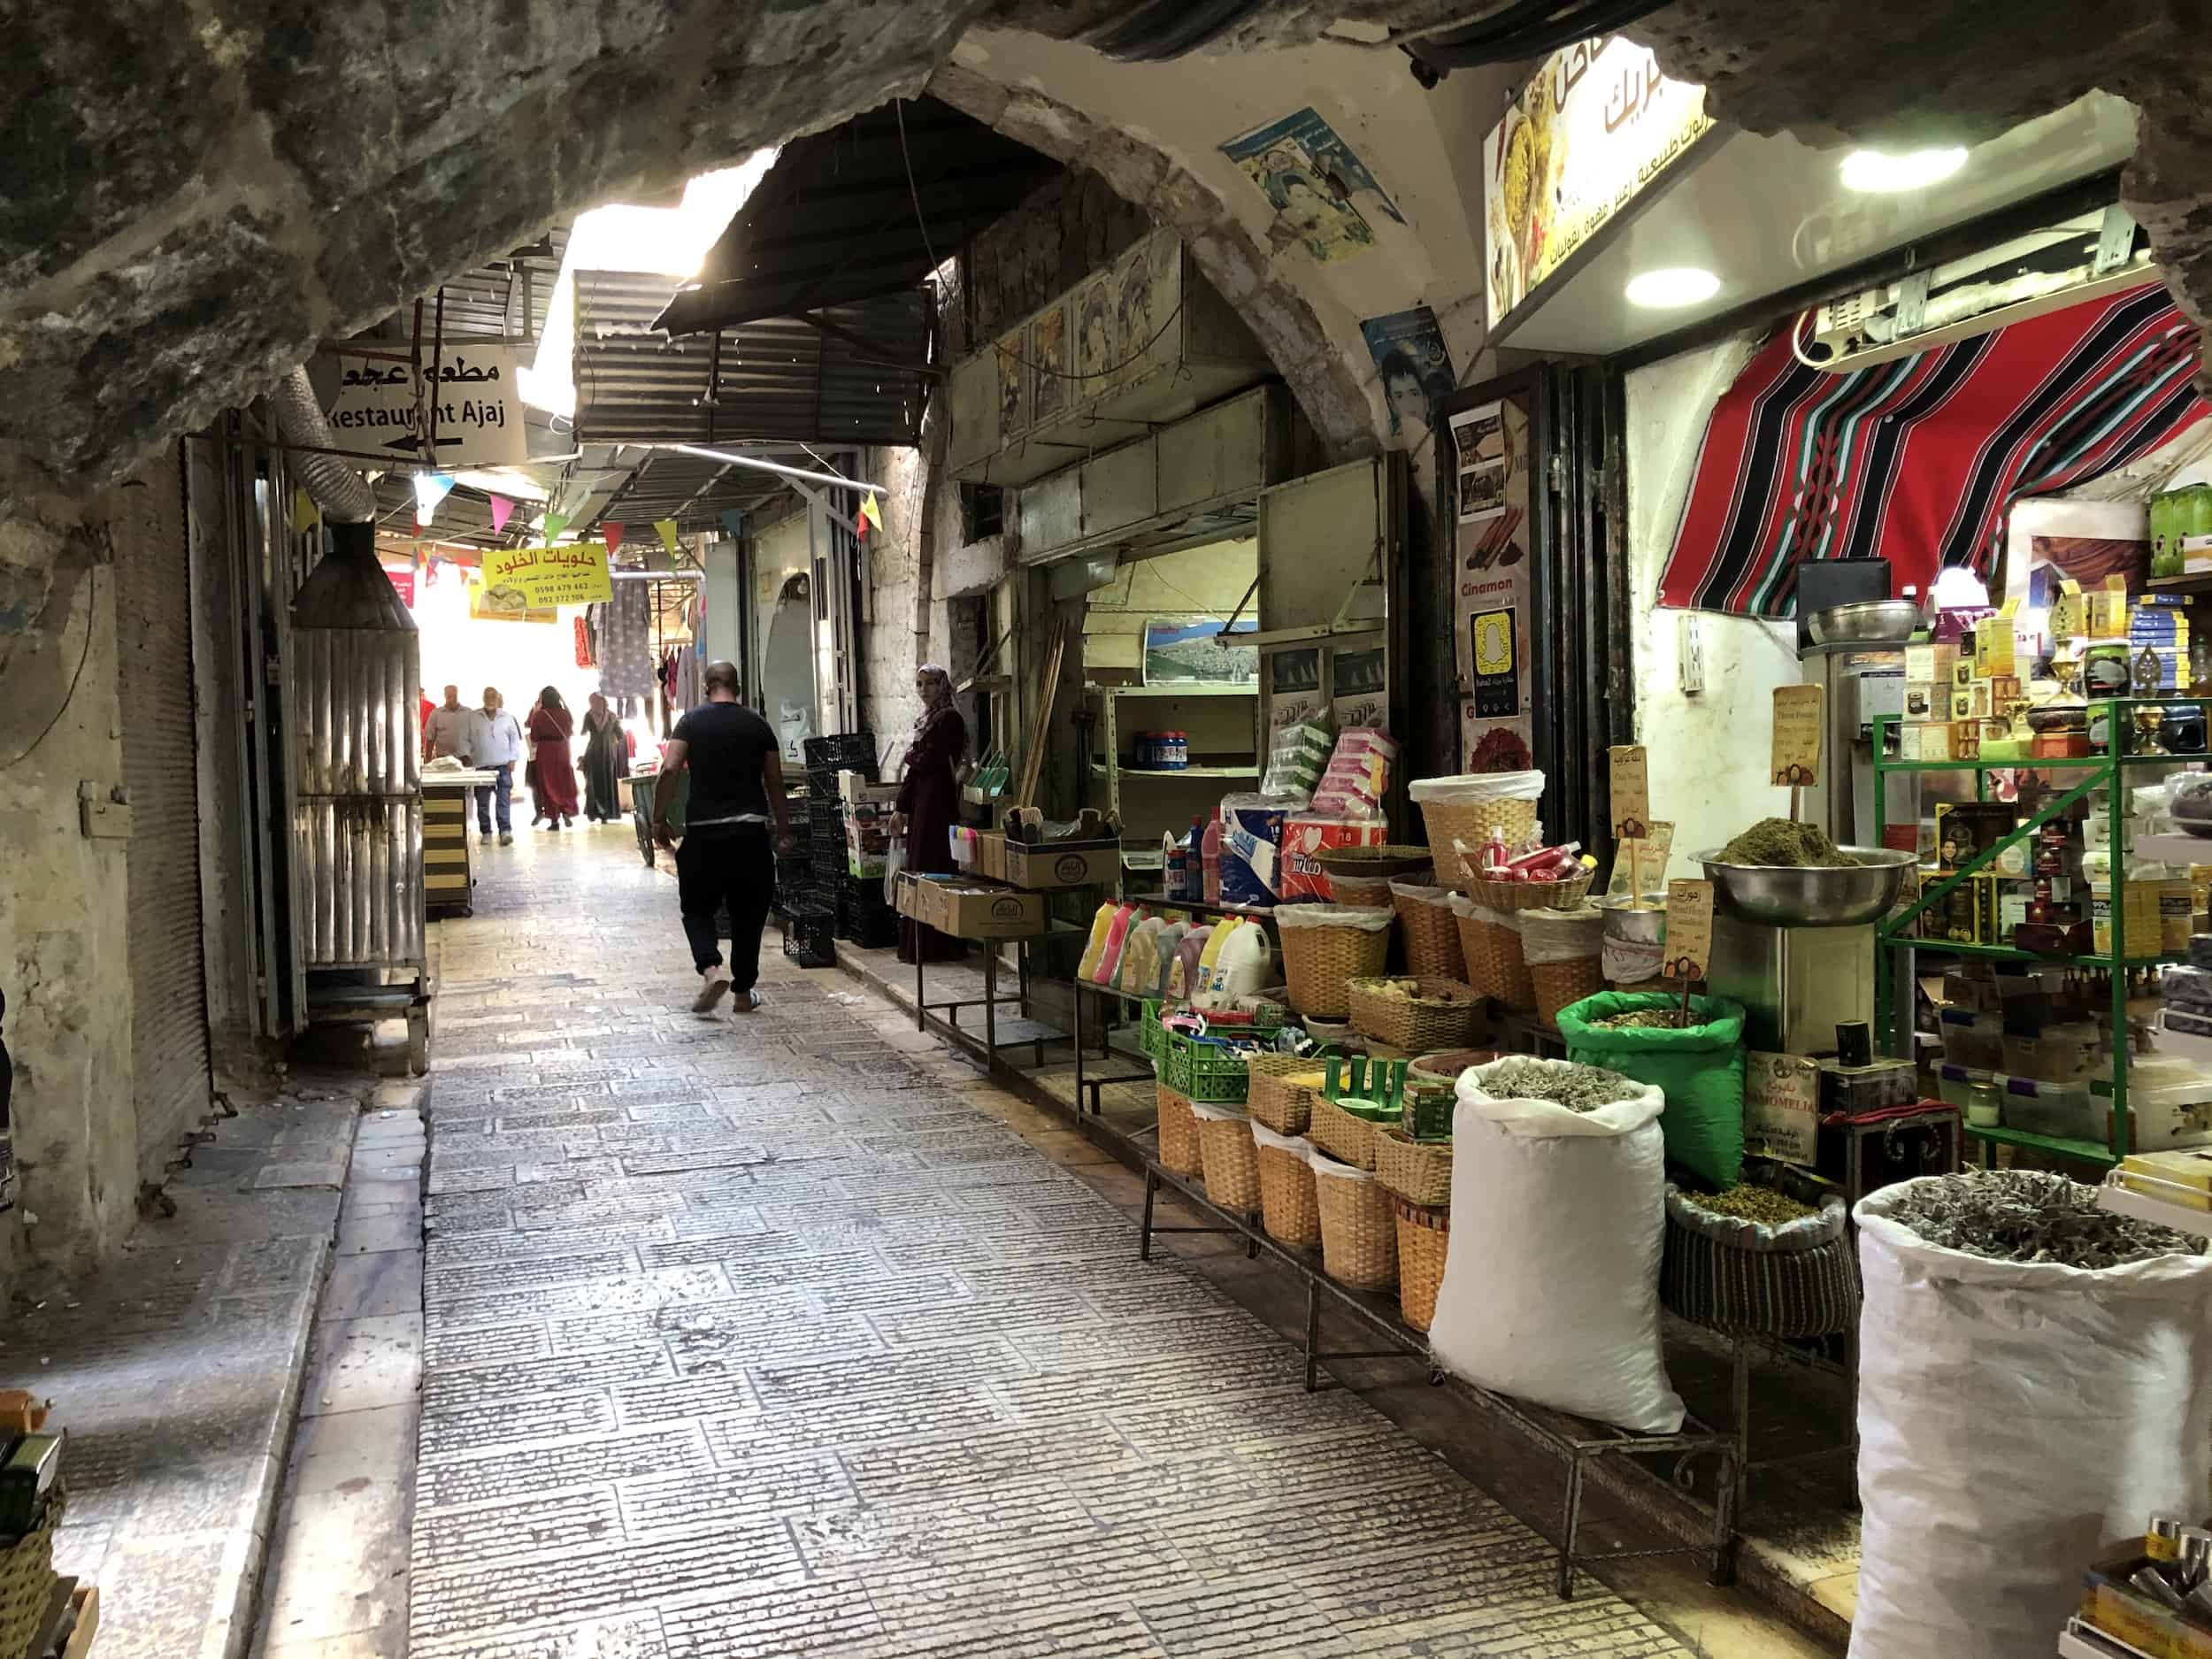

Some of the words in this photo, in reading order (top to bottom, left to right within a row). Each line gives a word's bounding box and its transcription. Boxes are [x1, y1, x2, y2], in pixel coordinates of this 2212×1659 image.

[1638, 137, 1679, 183] طبيعية
[423, 356, 500, 382] مطعم
[326, 403, 456, 428] estaurnt
[462, 399, 504, 428] Ajaj
[495, 551, 539, 575] الخلود
[542, 549, 596, 568] حلويات
[1339, 832, 1352, 842] 18
